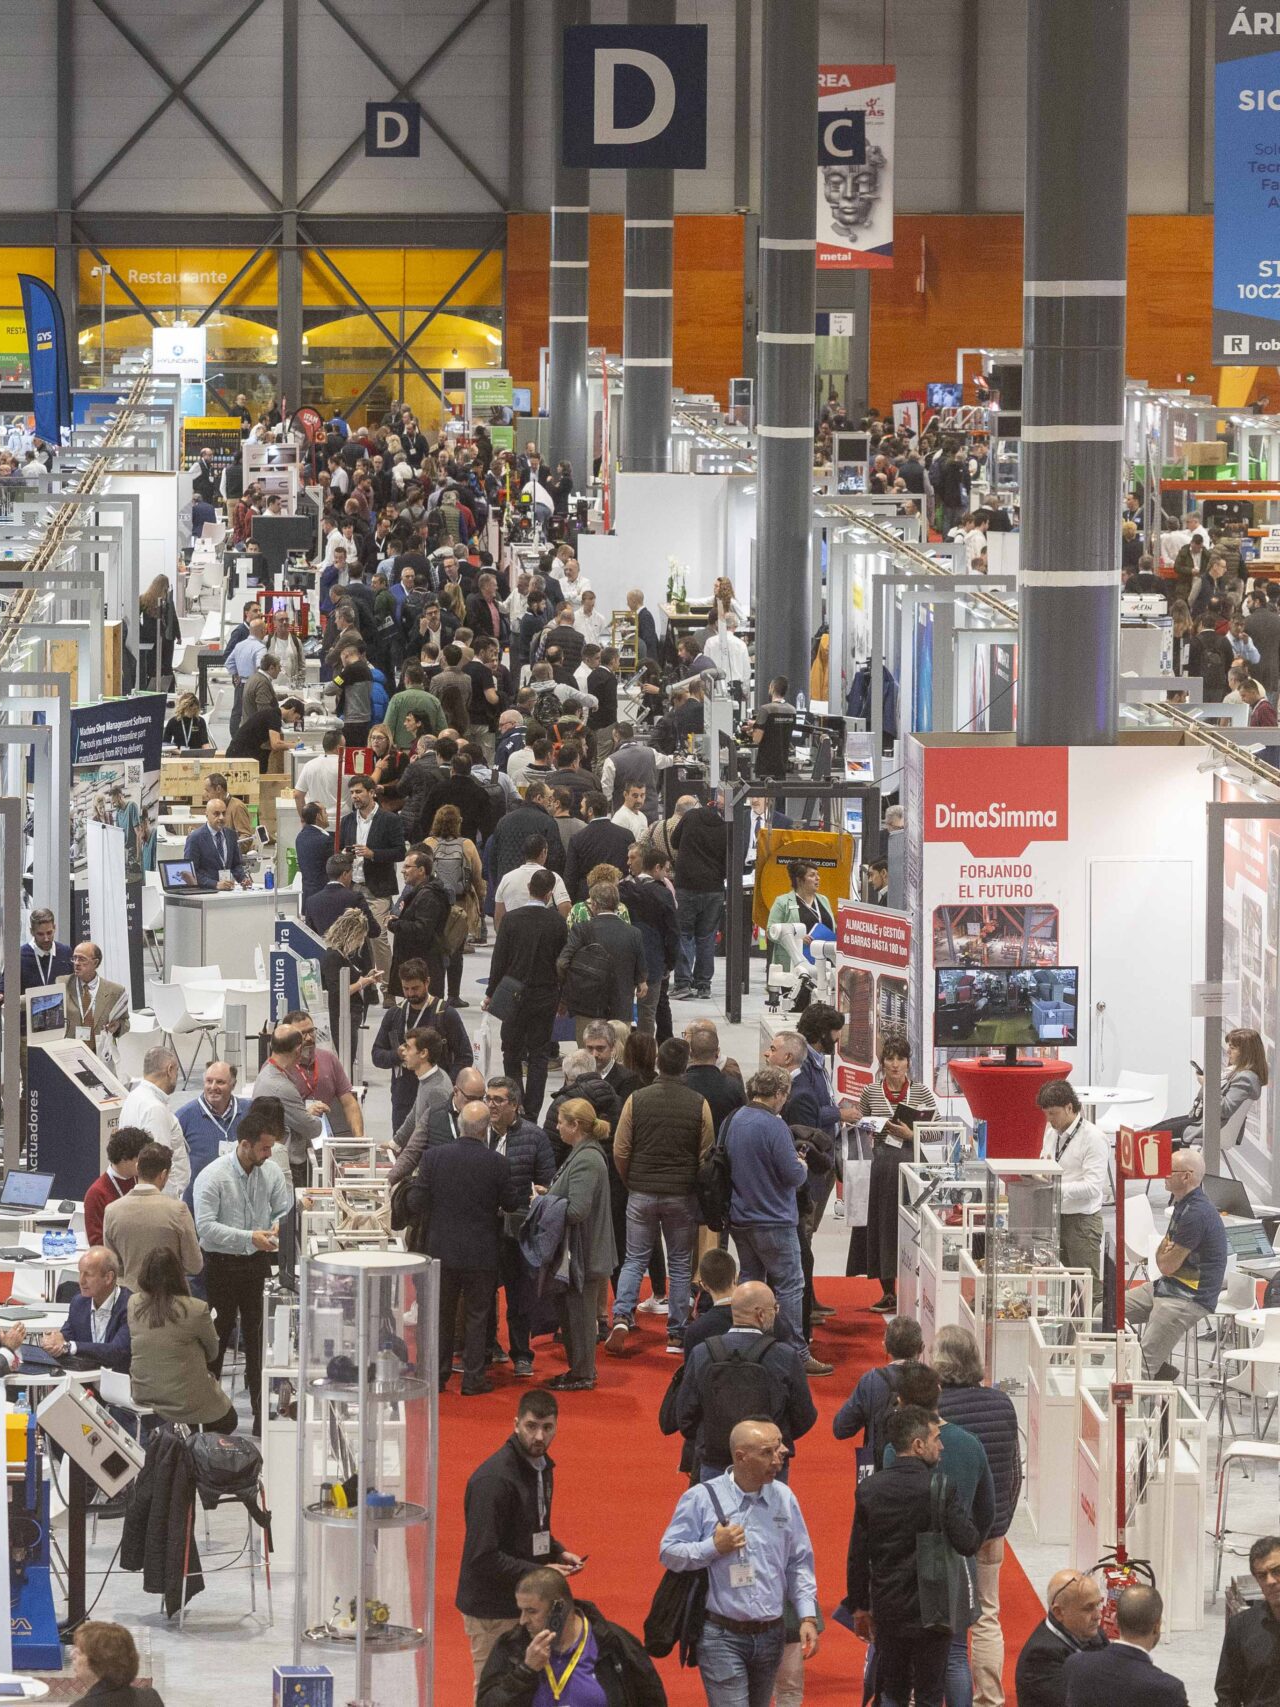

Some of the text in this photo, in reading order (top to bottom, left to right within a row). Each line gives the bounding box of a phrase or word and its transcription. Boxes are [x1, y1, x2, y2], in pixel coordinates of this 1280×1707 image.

[1228, 6, 1280, 35] ÁR
[818, 74, 851, 87] REA
[594, 49, 676, 144] D
[376, 111, 408, 149] D
[824, 119, 853, 157] C
[821, 252, 851, 262] metal
[128, 270, 227, 284] Restaurante
[1259, 260, 1280, 277] ST
[1237, 284, 1280, 299] 10C2
[37, 332, 52, 342] GYS
[1255, 339, 1280, 351] rob
[935, 803, 1057, 828] DimaSimma
[960, 864, 1032, 878] FORJANDO
[959, 884, 1032, 898] EL FUTURO
[846, 919, 878, 934] ALMACENAJE
[882, 926, 906, 940] GESTIÓN
[843, 934, 850, 943] de
[850, 935, 871, 949] BARRAS
[871, 939, 888, 951] HASTA
[889, 942, 898, 954] 180
[28, 1090, 38, 1172] Actuadores
